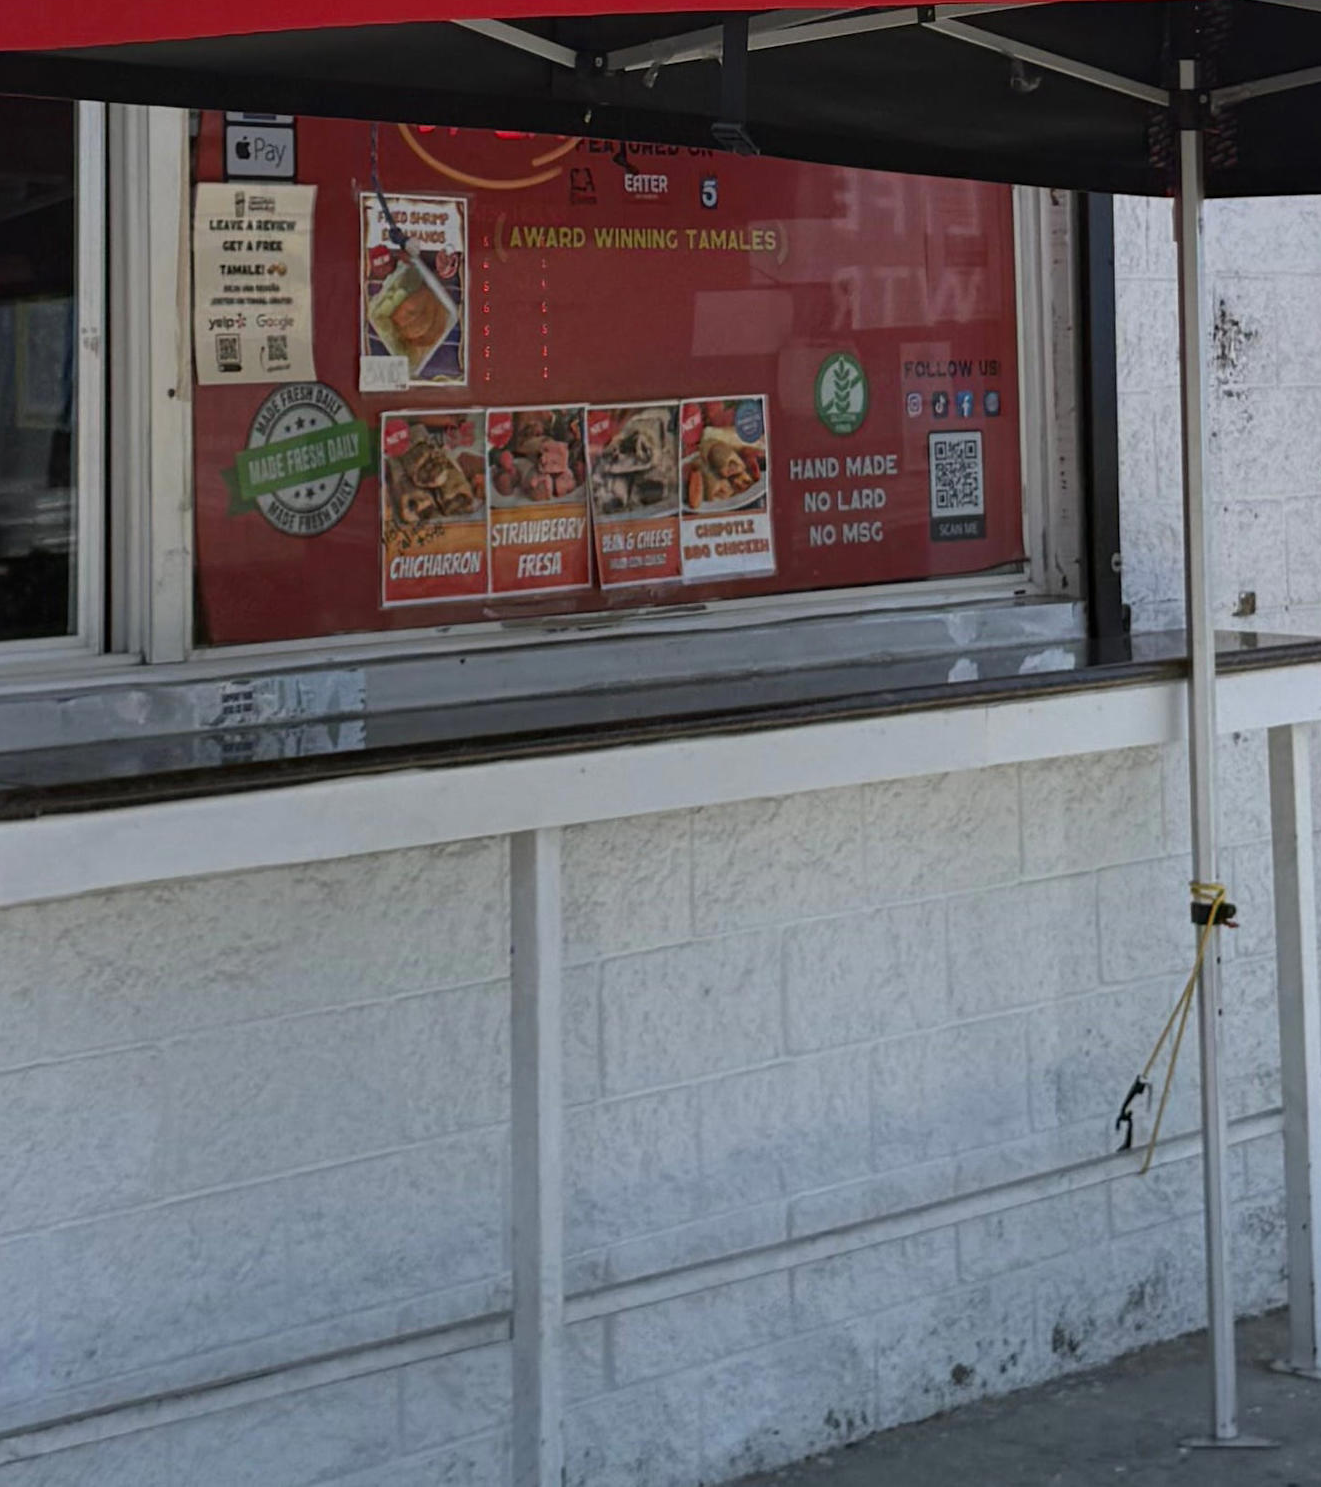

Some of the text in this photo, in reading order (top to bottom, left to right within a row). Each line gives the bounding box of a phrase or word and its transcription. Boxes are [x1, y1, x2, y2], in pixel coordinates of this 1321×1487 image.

[254, 137, 287, 169] Pay
[623, 173, 668, 193] EATER
[701, 179, 718, 208] 5
[209, 219, 297, 231] LEAVE A REVIEW
[222, 240, 283, 252] GET A FREE
[509, 227, 778, 252] AWARD WINNING TAMALES
[209, 315, 295, 330] yelp Google
[904, 359, 973, 379] FOLLOW
[280, 385, 314, 407] FRESH
[314, 388, 344, 417] DAILY
[247, 432, 360, 486] MADE FRESH DAILY
[789, 454, 898, 481] HAND MADE
[804, 488, 887, 513] NO LARD
[298, 511, 332, 531] FRESH
[491, 517, 586, 548] STRAWBERRY
[695, 518, 756, 539] CHIPOTLE
[939, 521, 964, 537] SCAN
[636, 528, 674, 550] CHEESE
[809, 521, 884, 547] NO MSG
[714, 538, 770, 557] CHICKEN
[389, 550, 483, 580] CHICHARRON
[517, 551, 562, 579] FRESA
